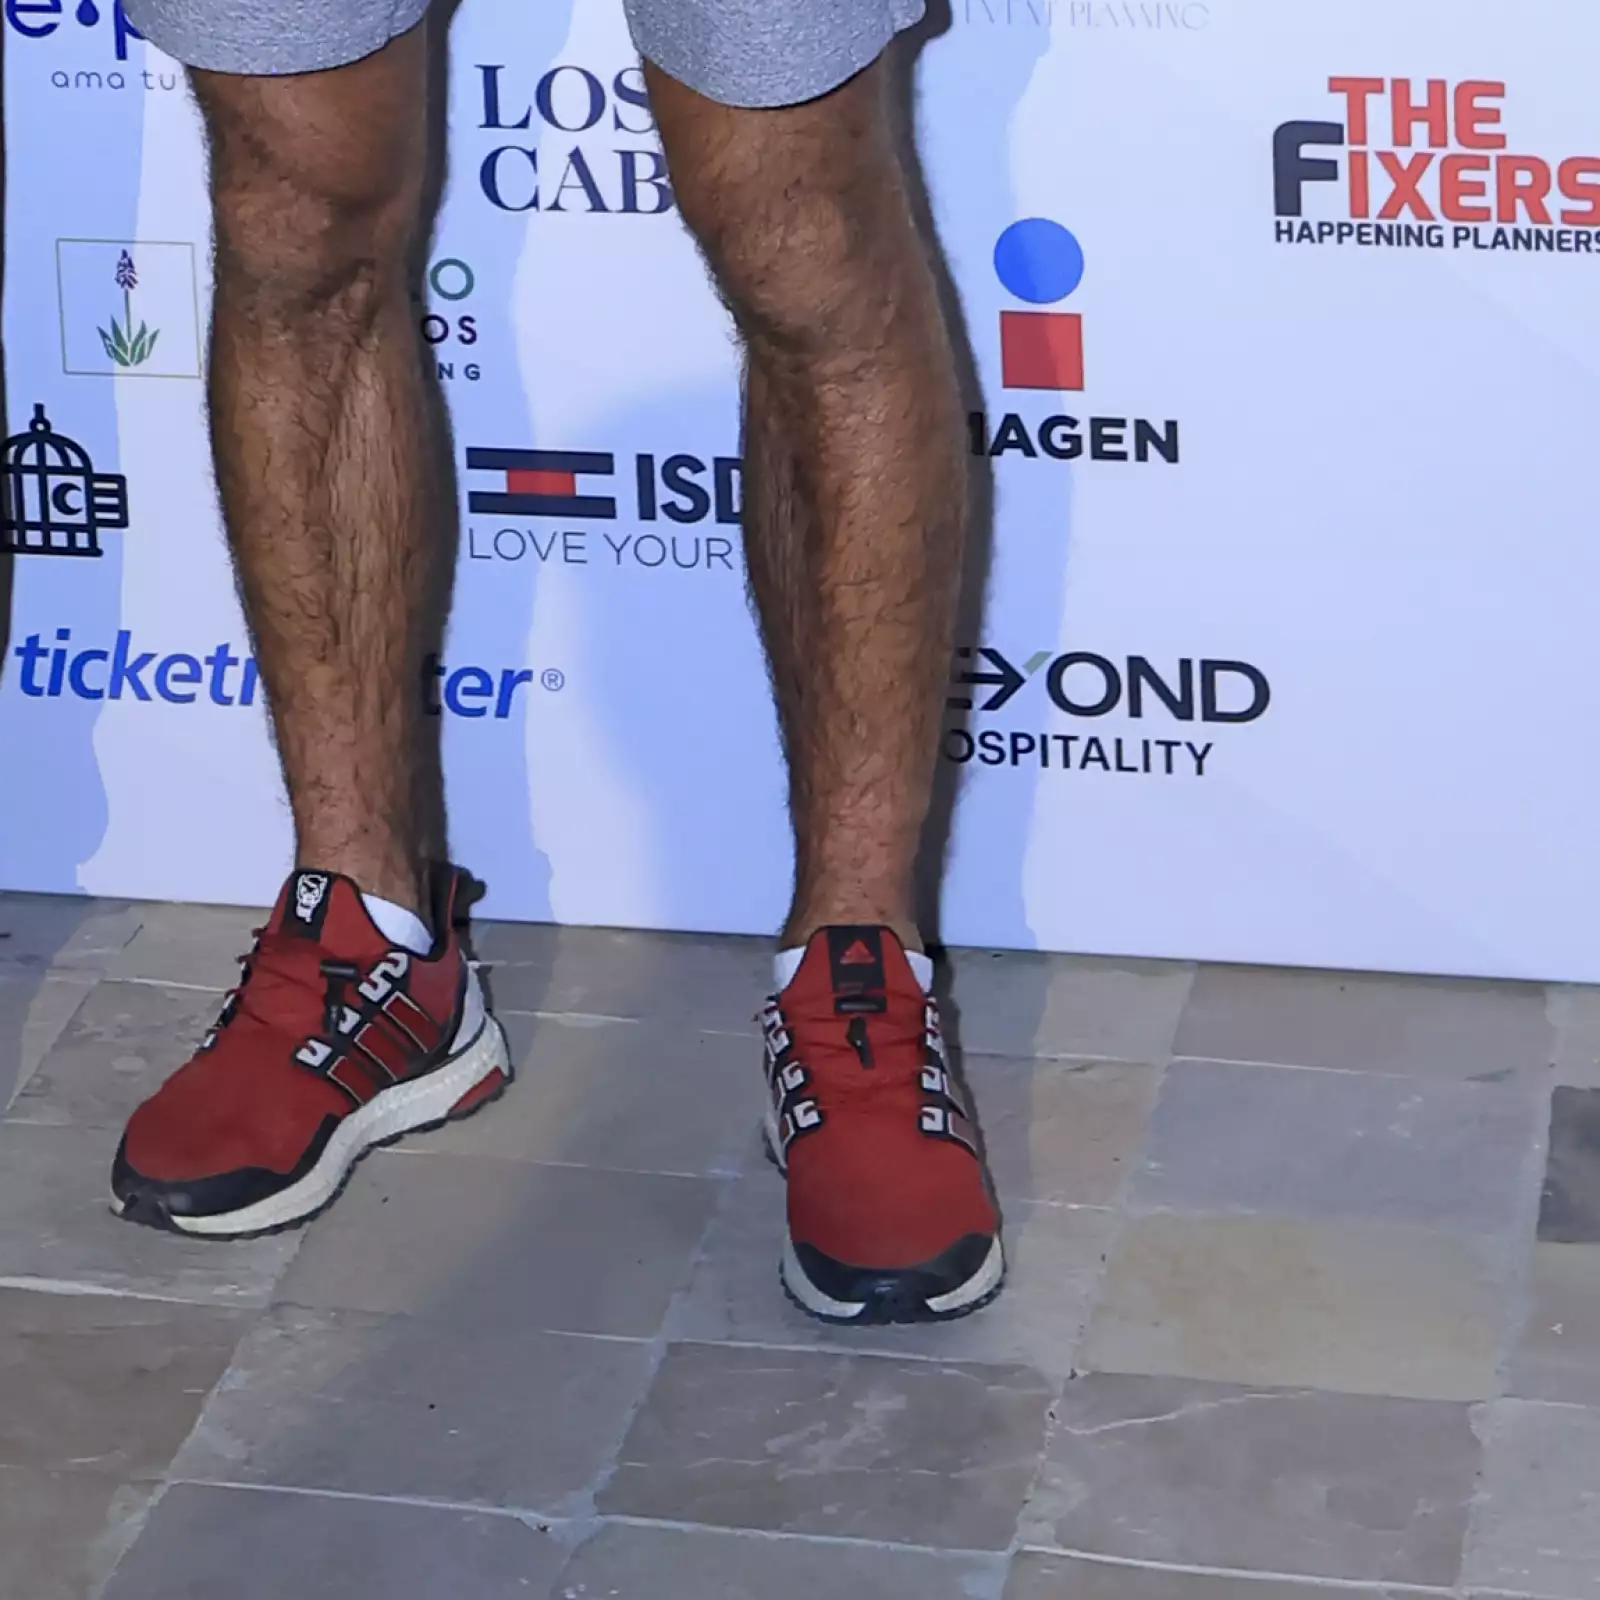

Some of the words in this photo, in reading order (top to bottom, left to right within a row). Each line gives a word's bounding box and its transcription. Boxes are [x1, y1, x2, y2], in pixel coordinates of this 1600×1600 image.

[51, 69, 125, 91] ama
[142, 65, 177, 91] tu
[1328, 77, 1506, 150] THE
[1274, 219, 1445, 250] HAPPENING
[467, 527, 587, 565] LOVE
[603, 531, 733, 571] YOUR
[942, 728, 1214, 777] OSPITALITY
